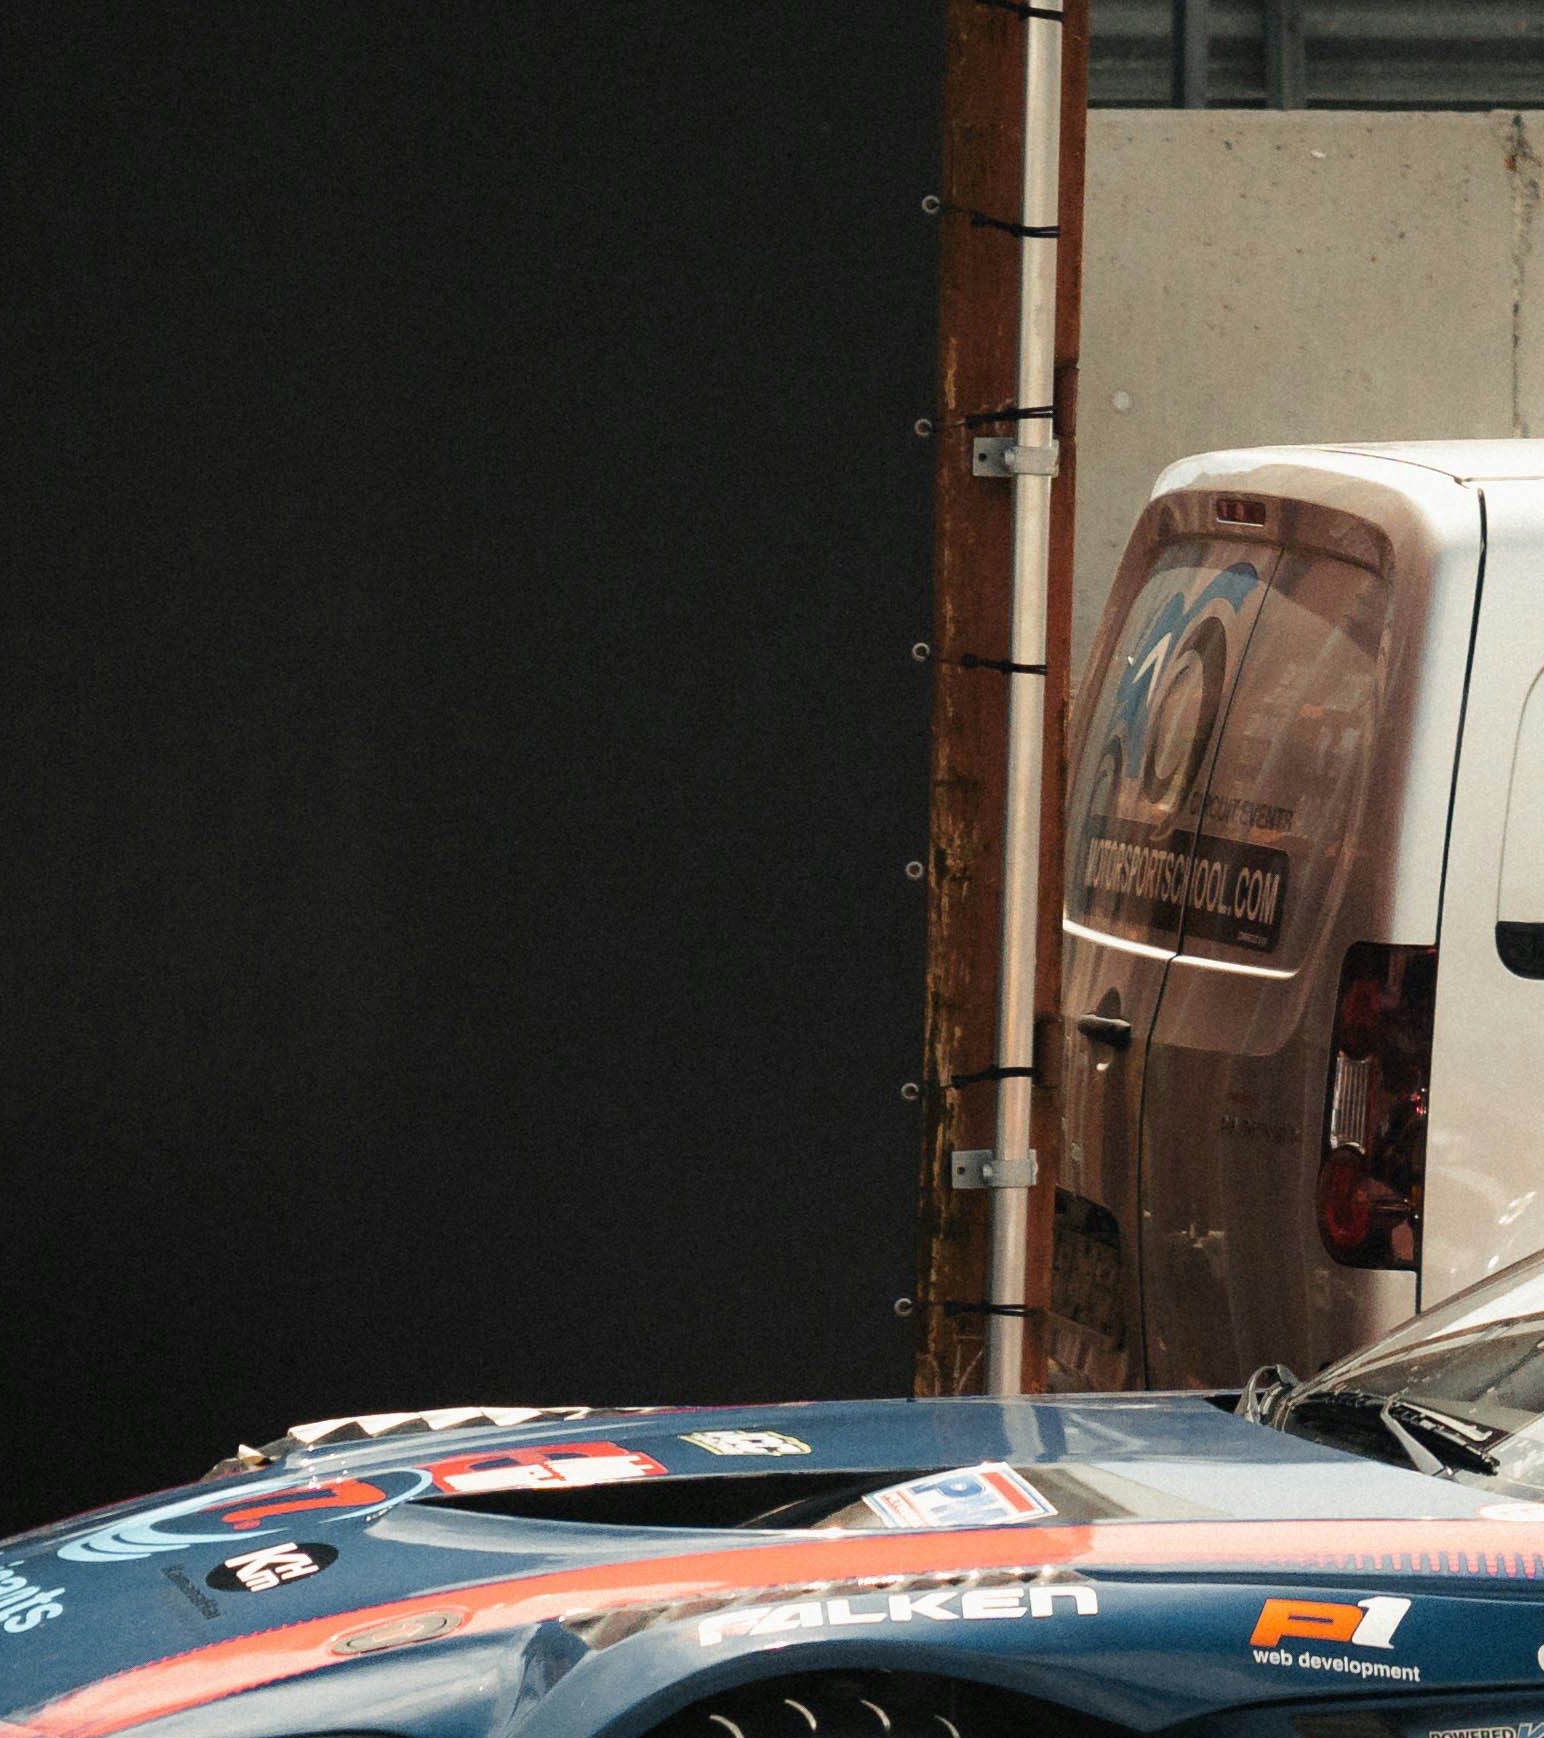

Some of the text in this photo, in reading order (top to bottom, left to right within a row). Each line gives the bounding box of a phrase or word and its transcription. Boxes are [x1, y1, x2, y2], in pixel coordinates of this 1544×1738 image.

[699, 1583, 1099, 1647] FALKEN
[1253, 1649, 1421, 1683] web development
